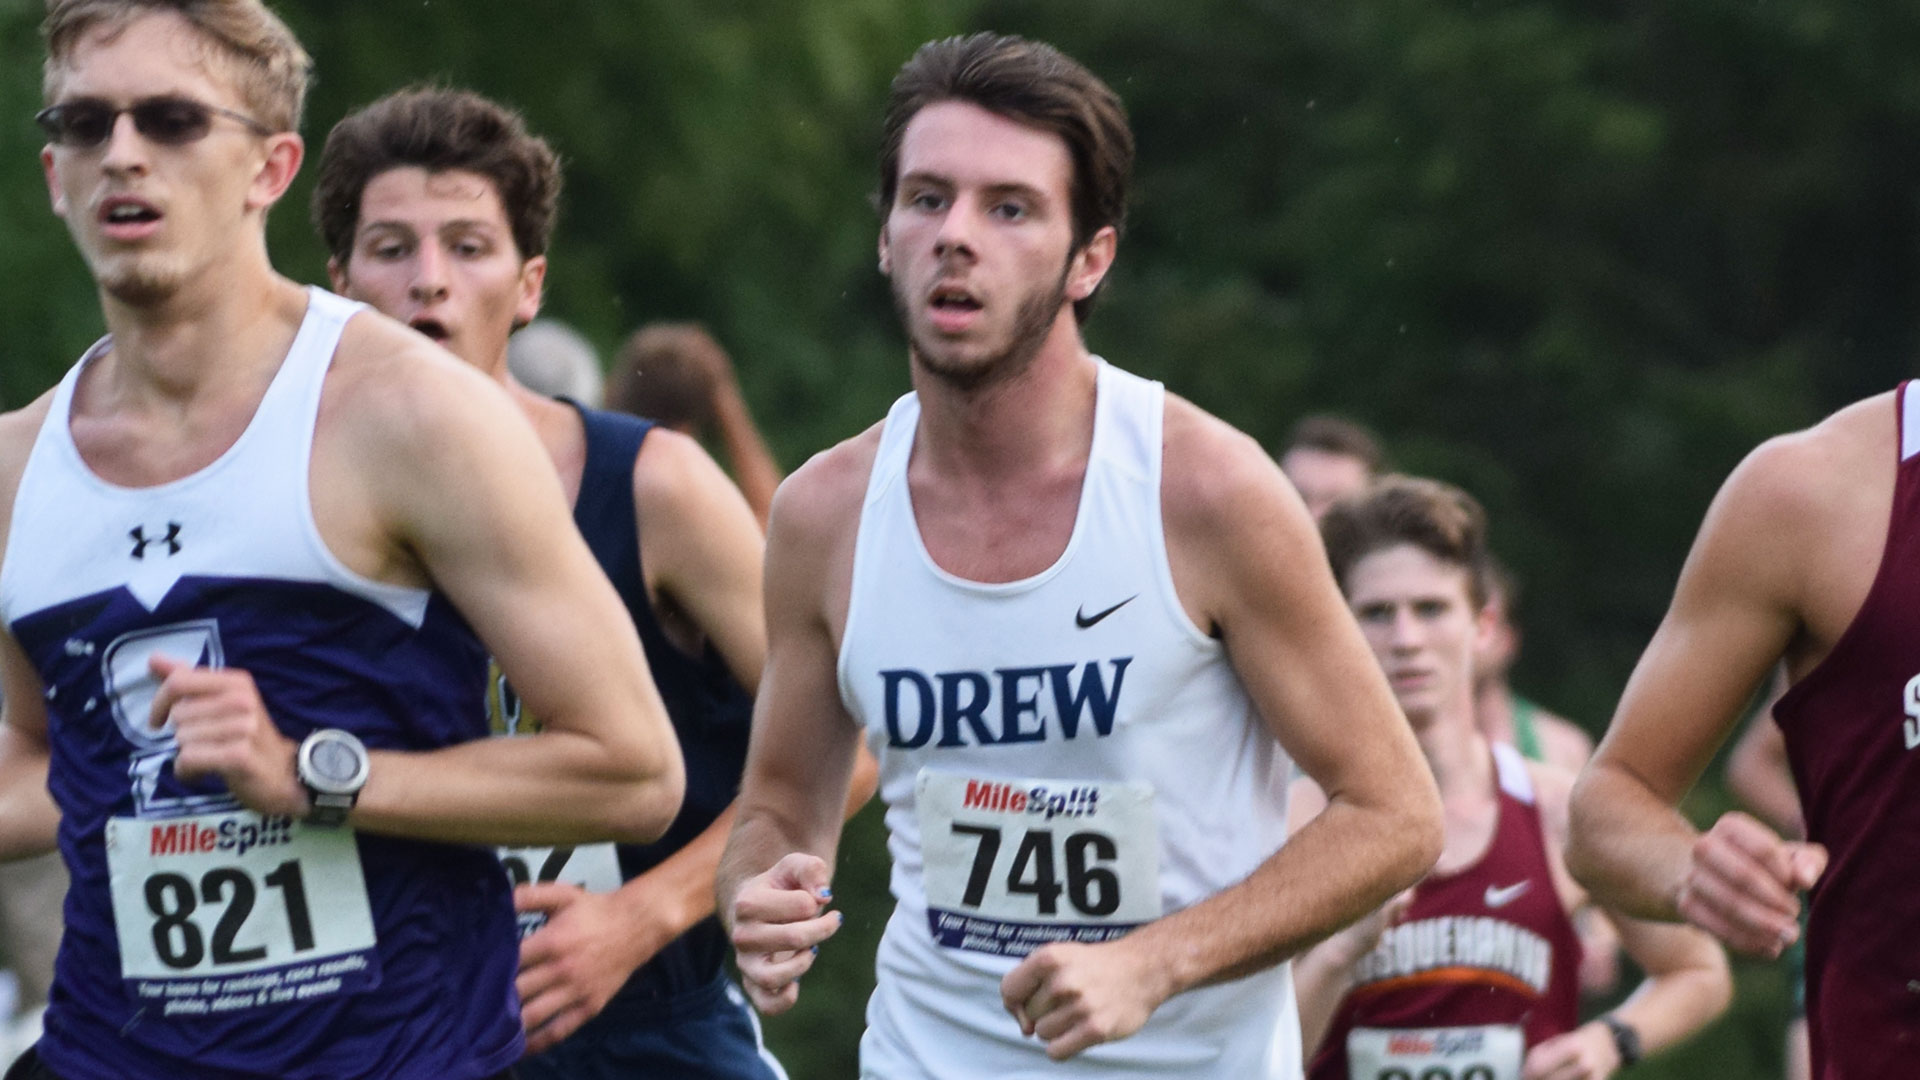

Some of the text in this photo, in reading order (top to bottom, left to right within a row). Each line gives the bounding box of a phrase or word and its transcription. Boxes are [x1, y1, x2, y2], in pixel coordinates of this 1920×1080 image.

[878, 656, 1134, 750] DREW
[963, 779, 1102, 820] MileSplit
[150, 814, 292, 857] MileSplit
[951, 823, 1121, 916] 746
[144, 859, 316, 970] 821
[939, 911, 964, 930] Your
[998, 923, 1017, 939] for
[138, 979, 164, 997] Your
[201, 979, 220, 995] for
